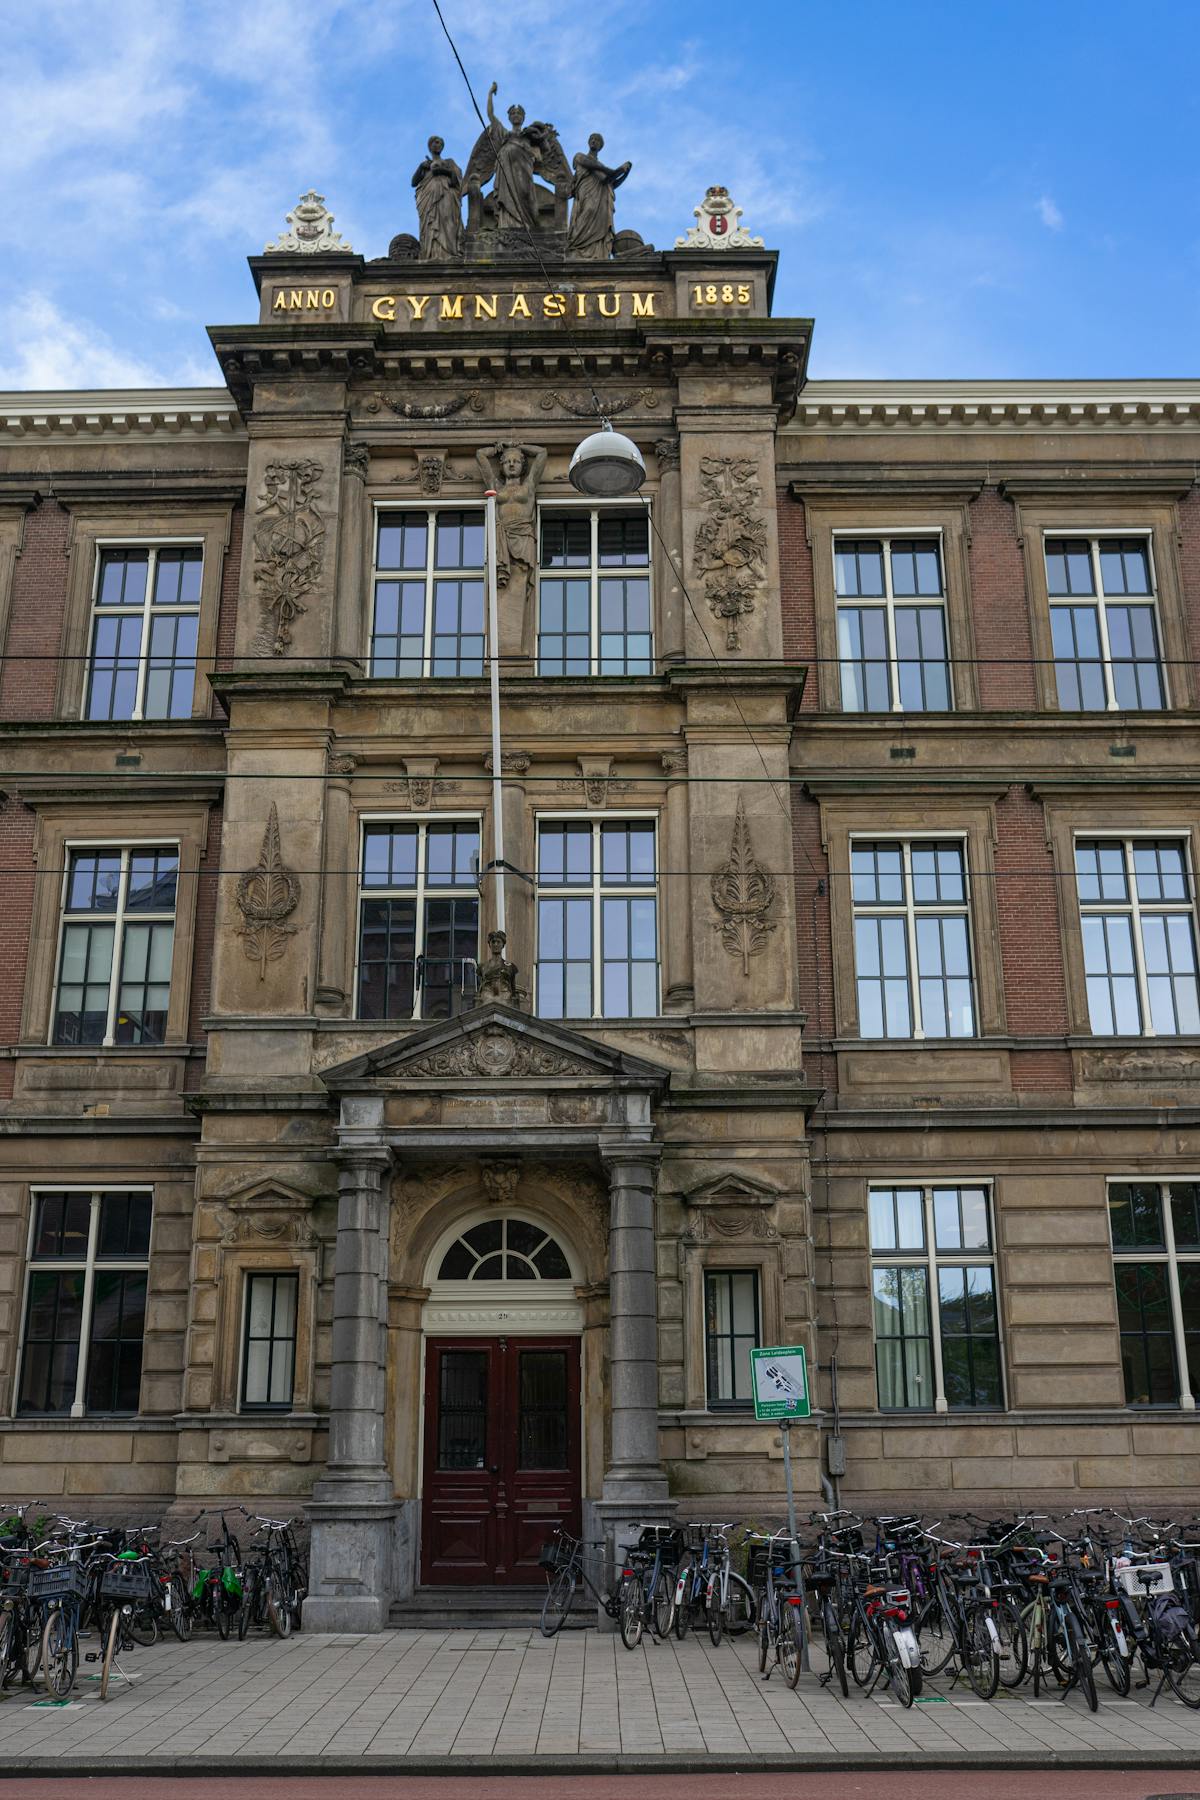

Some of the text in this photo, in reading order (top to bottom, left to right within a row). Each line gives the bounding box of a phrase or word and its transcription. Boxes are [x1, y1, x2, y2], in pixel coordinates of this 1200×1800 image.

[273, 289, 335, 310] ANNO
[694, 284, 750, 304] 1885
[371, 292, 656, 321] GYMNASIUM
